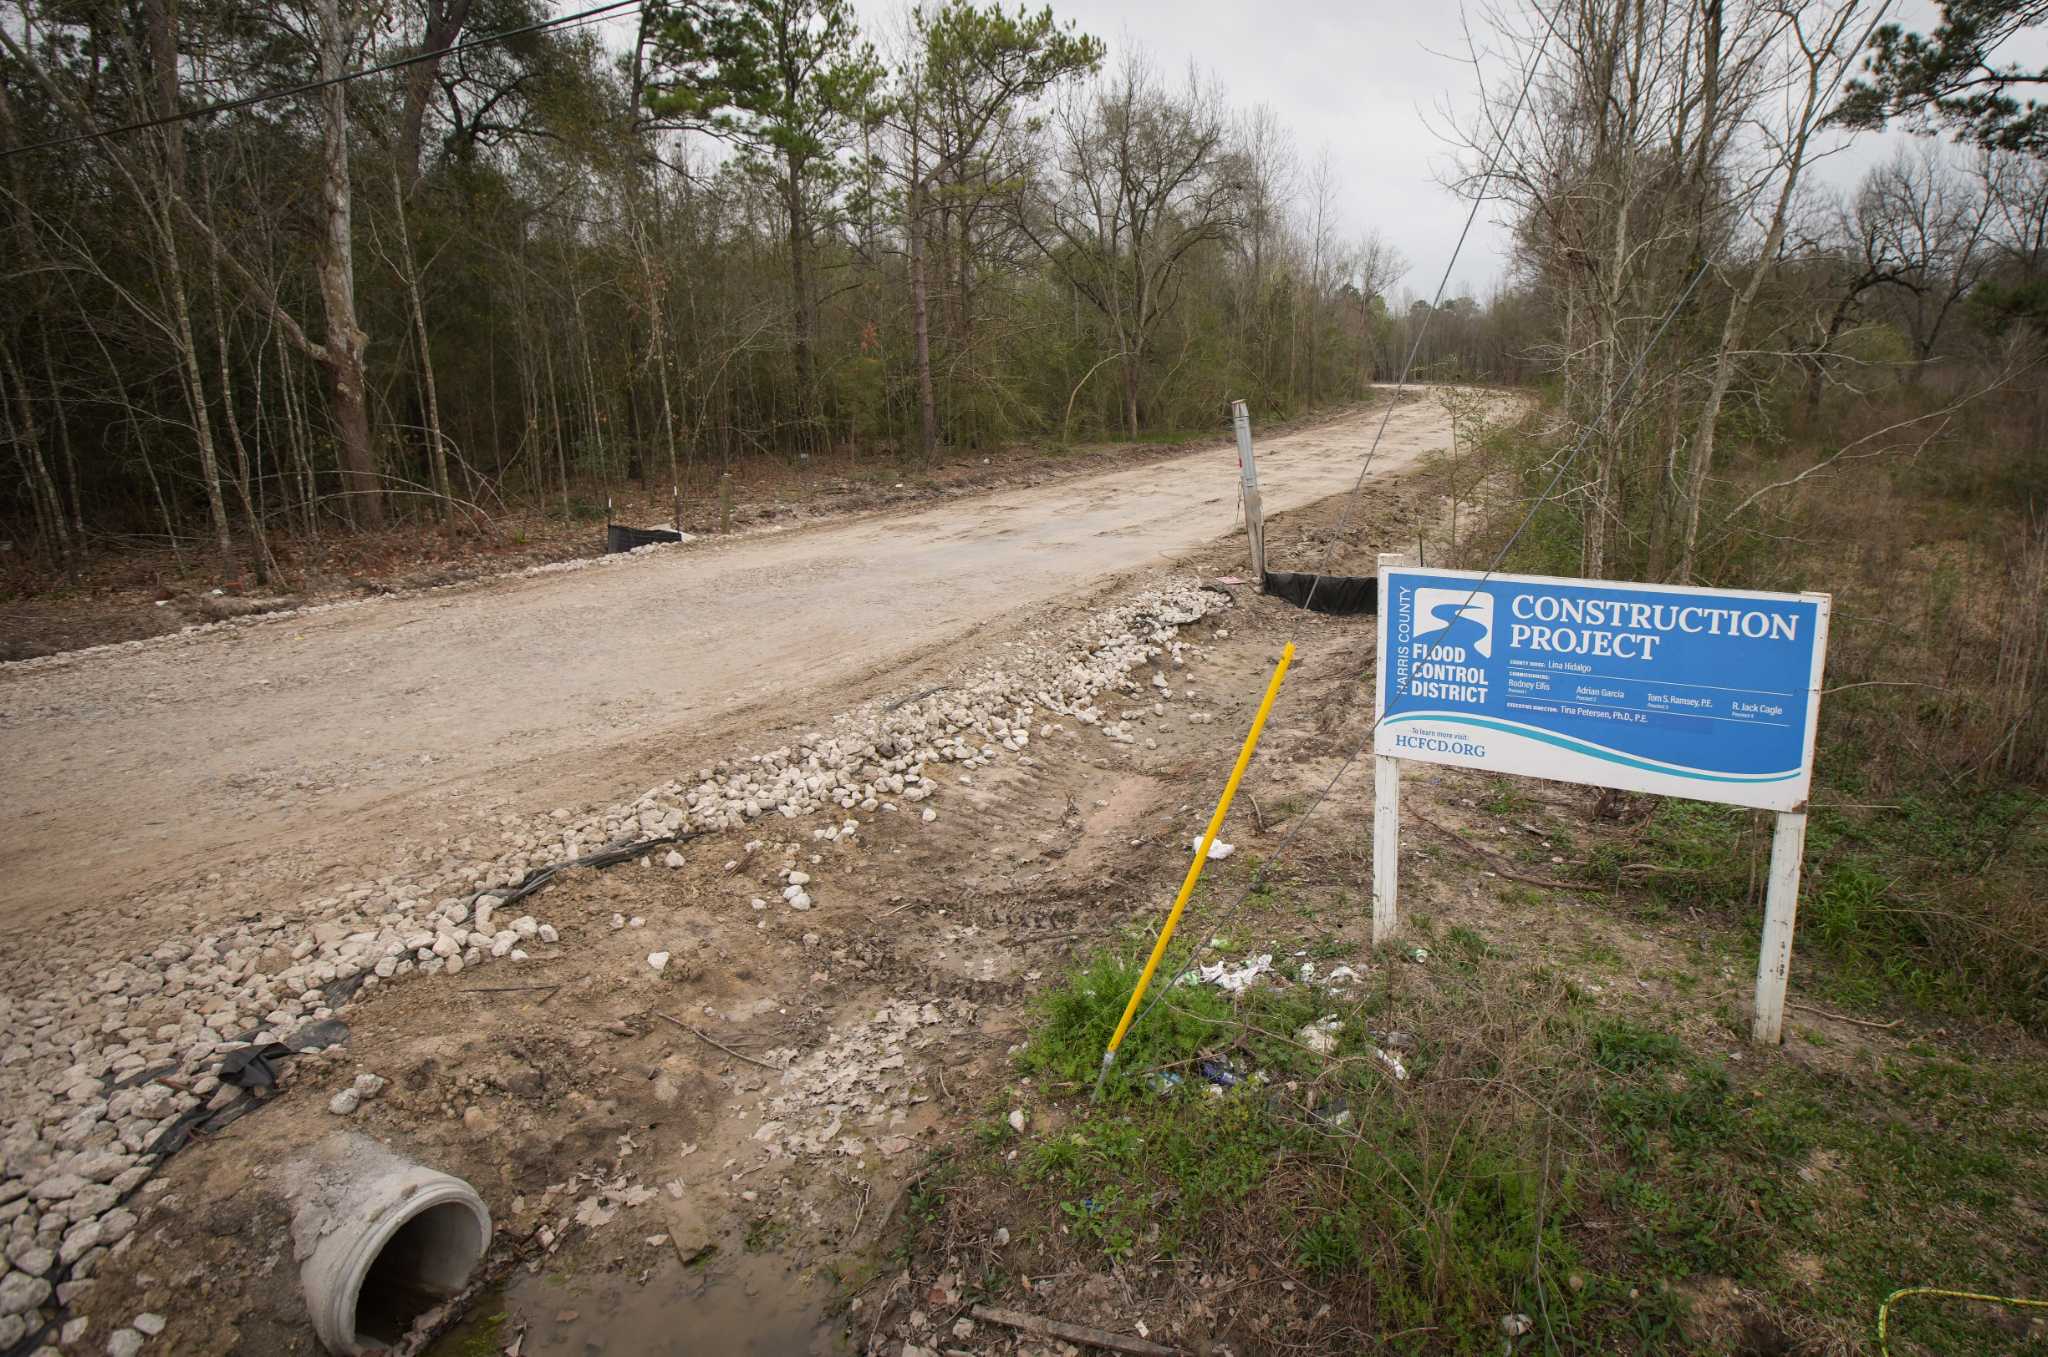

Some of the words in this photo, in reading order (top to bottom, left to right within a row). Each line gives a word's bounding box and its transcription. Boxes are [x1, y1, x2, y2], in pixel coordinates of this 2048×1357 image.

[1397, 586, 1411, 643] COUNTY
[1511, 594, 1799, 641] CONSTRUCTION
[1509, 624, 1660, 660] PROJECT
[1412, 643, 1466, 663] FLOOD
[1397, 646, 1409, 695] HARRIS
[1411, 661, 1489, 685] CONTROL
[1548, 660, 1563, 670] Lina
[1564, 662, 1592, 673] Hidalgo
[1411, 681, 1488, 704] DISTRICT
[1508, 679, 1534, 690] Rodney
[1576, 686, 1600, 696] Adrian
[1601, 688, 1625, 699] Garcia
[1647, 693, 1662, 702] Tom
[1732, 701, 1740, 711] R.
[1741, 703, 1758, 713] Jack
[1561, 705, 1576, 715] Tina
[1577, 708, 1612, 720] Petersen,
[1419, 728, 1435, 737] learn
[1436, 731, 1453, 739] more
[1395, 734, 1486, 758] HCFCD.ORG
